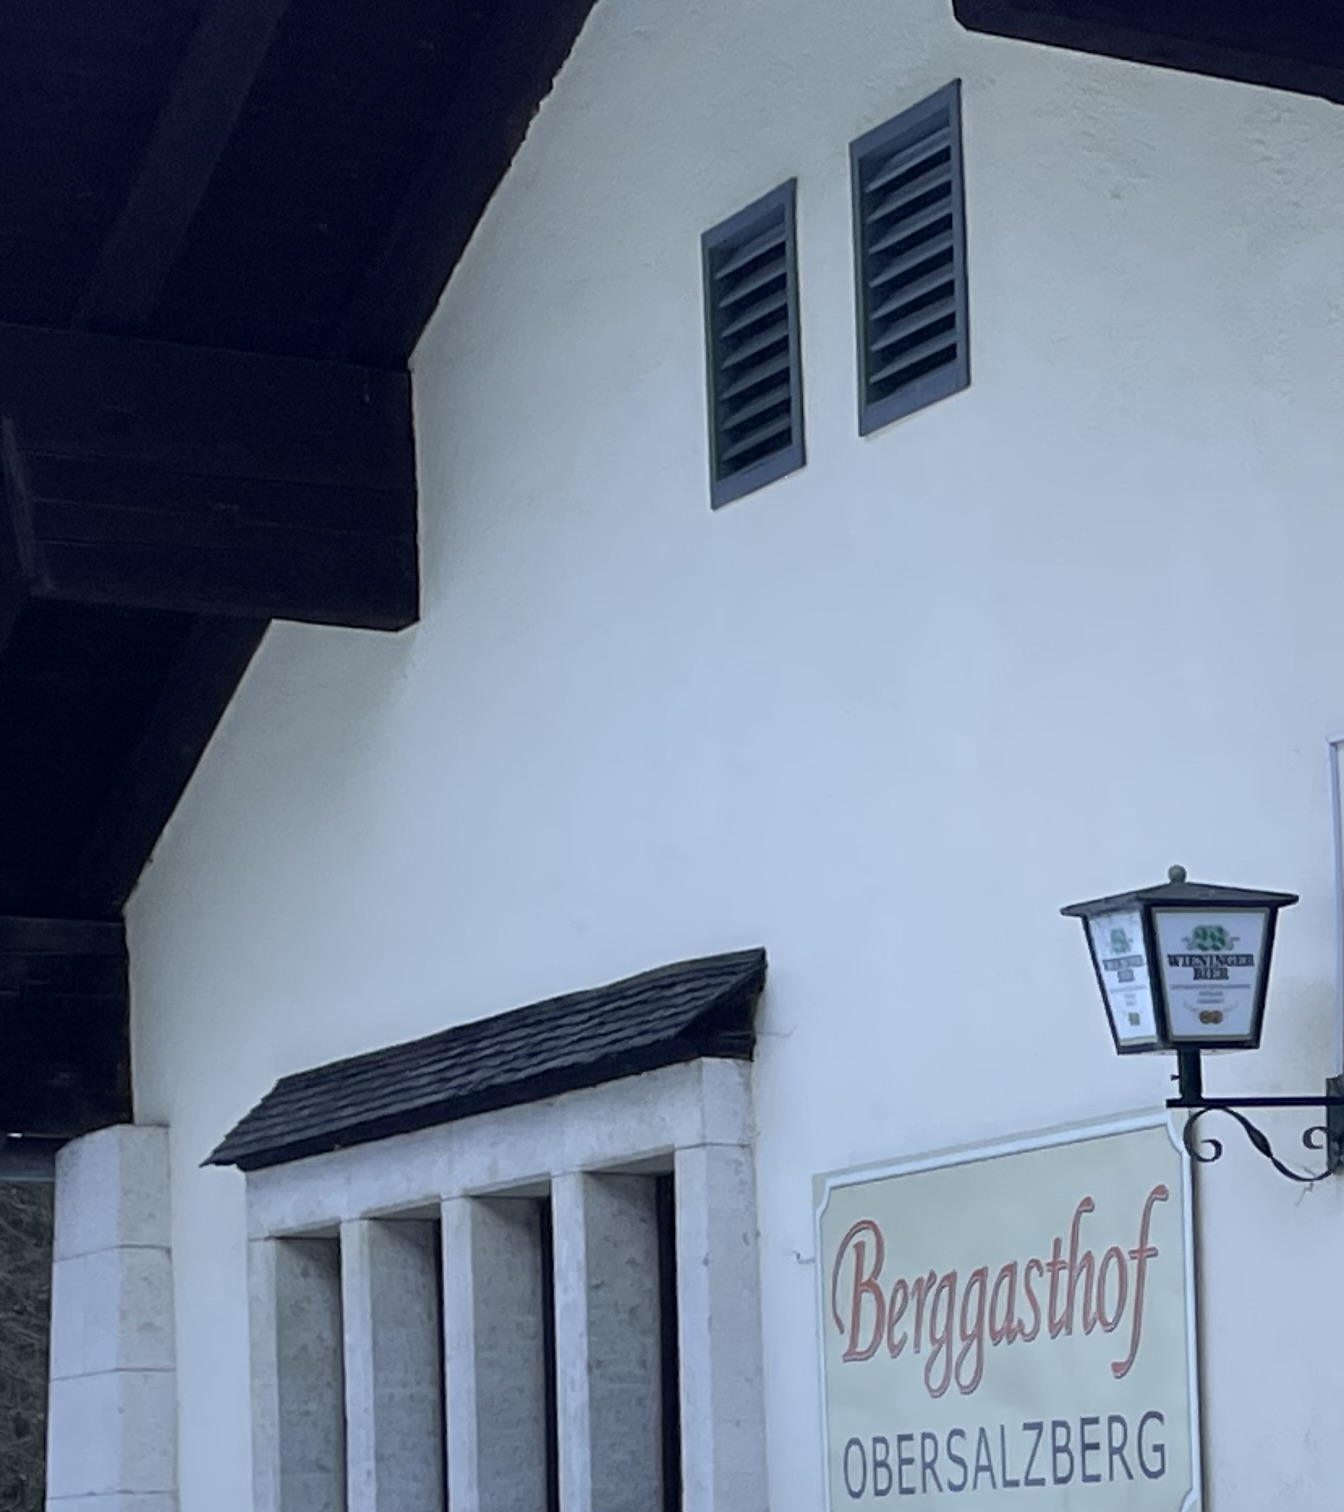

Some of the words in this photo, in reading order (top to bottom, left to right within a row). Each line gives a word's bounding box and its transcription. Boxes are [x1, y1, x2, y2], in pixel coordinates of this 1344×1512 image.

[1167, 954, 1255, 967] WIENINGER
[832, 1184, 1169, 1399] Berggasthof
[843, 1411, 1167, 1499] OBERSALZBERG
